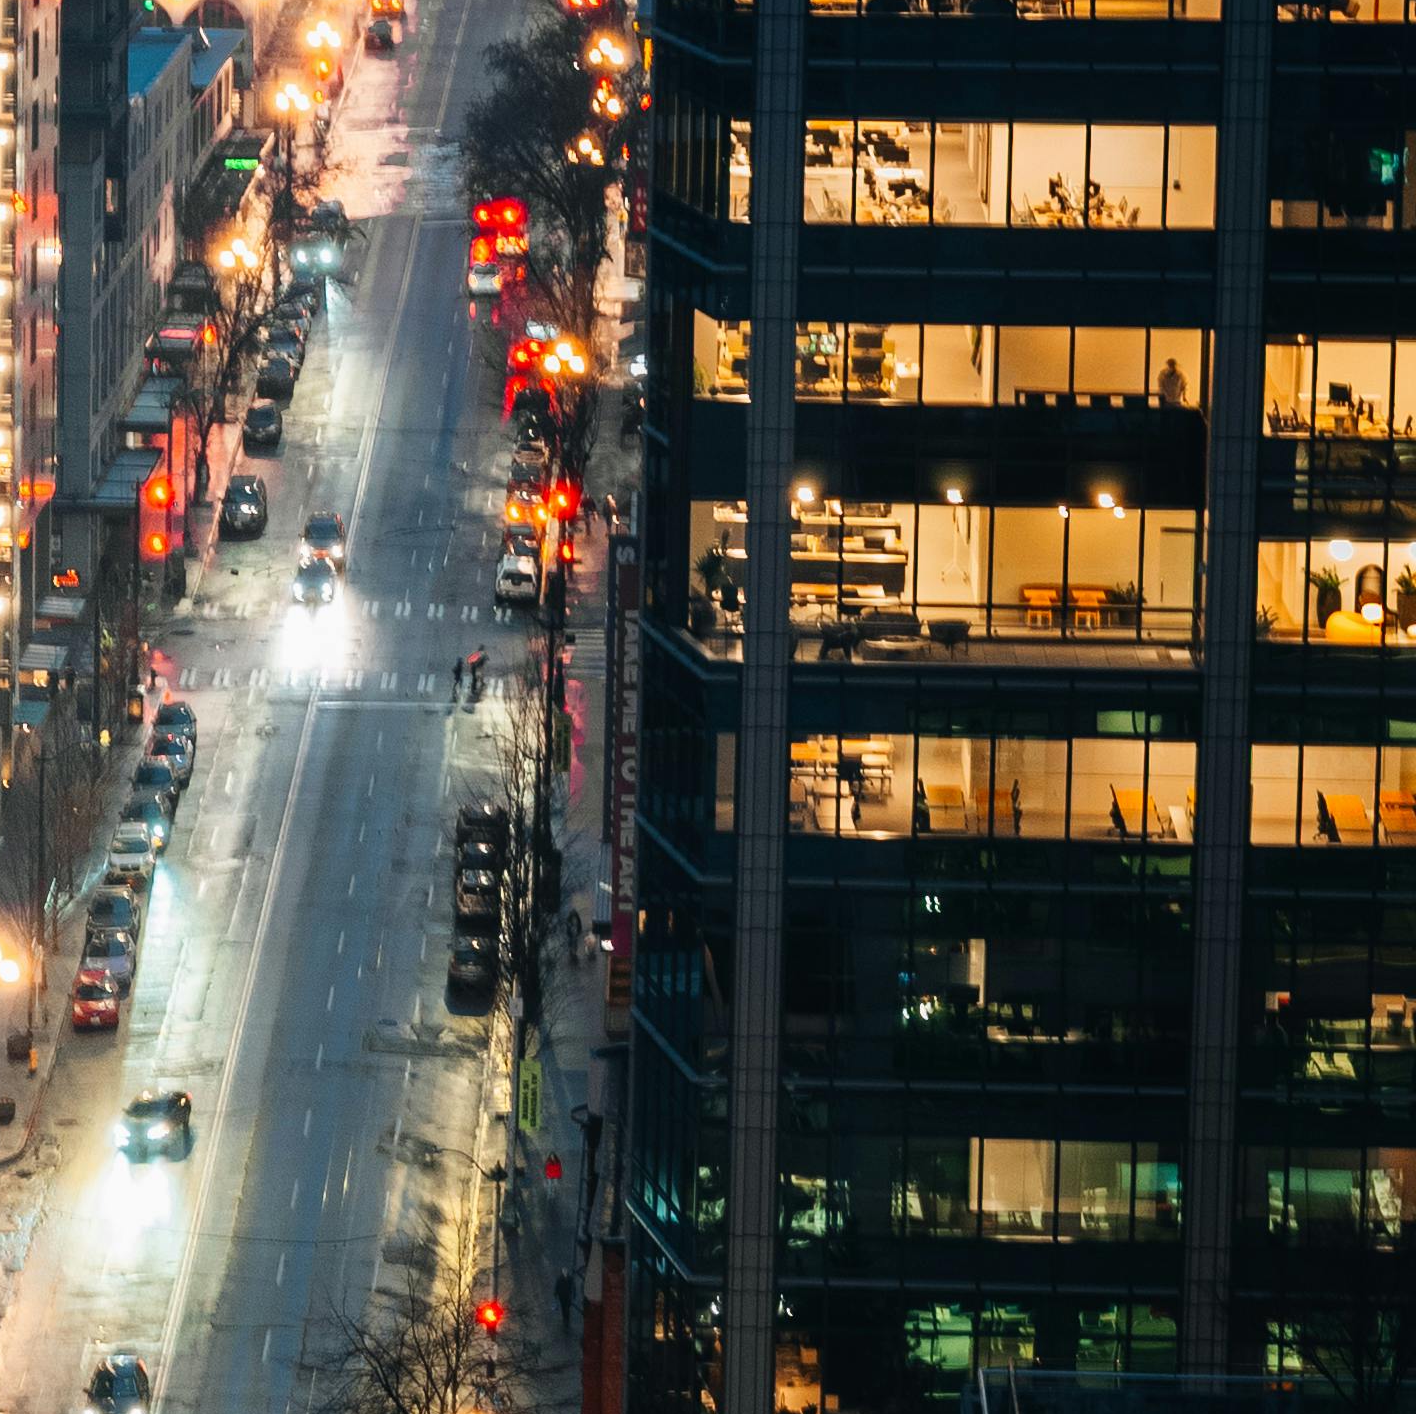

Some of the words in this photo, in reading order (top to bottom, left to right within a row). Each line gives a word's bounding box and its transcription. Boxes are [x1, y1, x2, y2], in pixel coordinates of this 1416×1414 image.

[621, 690, 637, 734] ME
[620, 746, 636, 782] TO
[619, 794, 635, 848] THE
